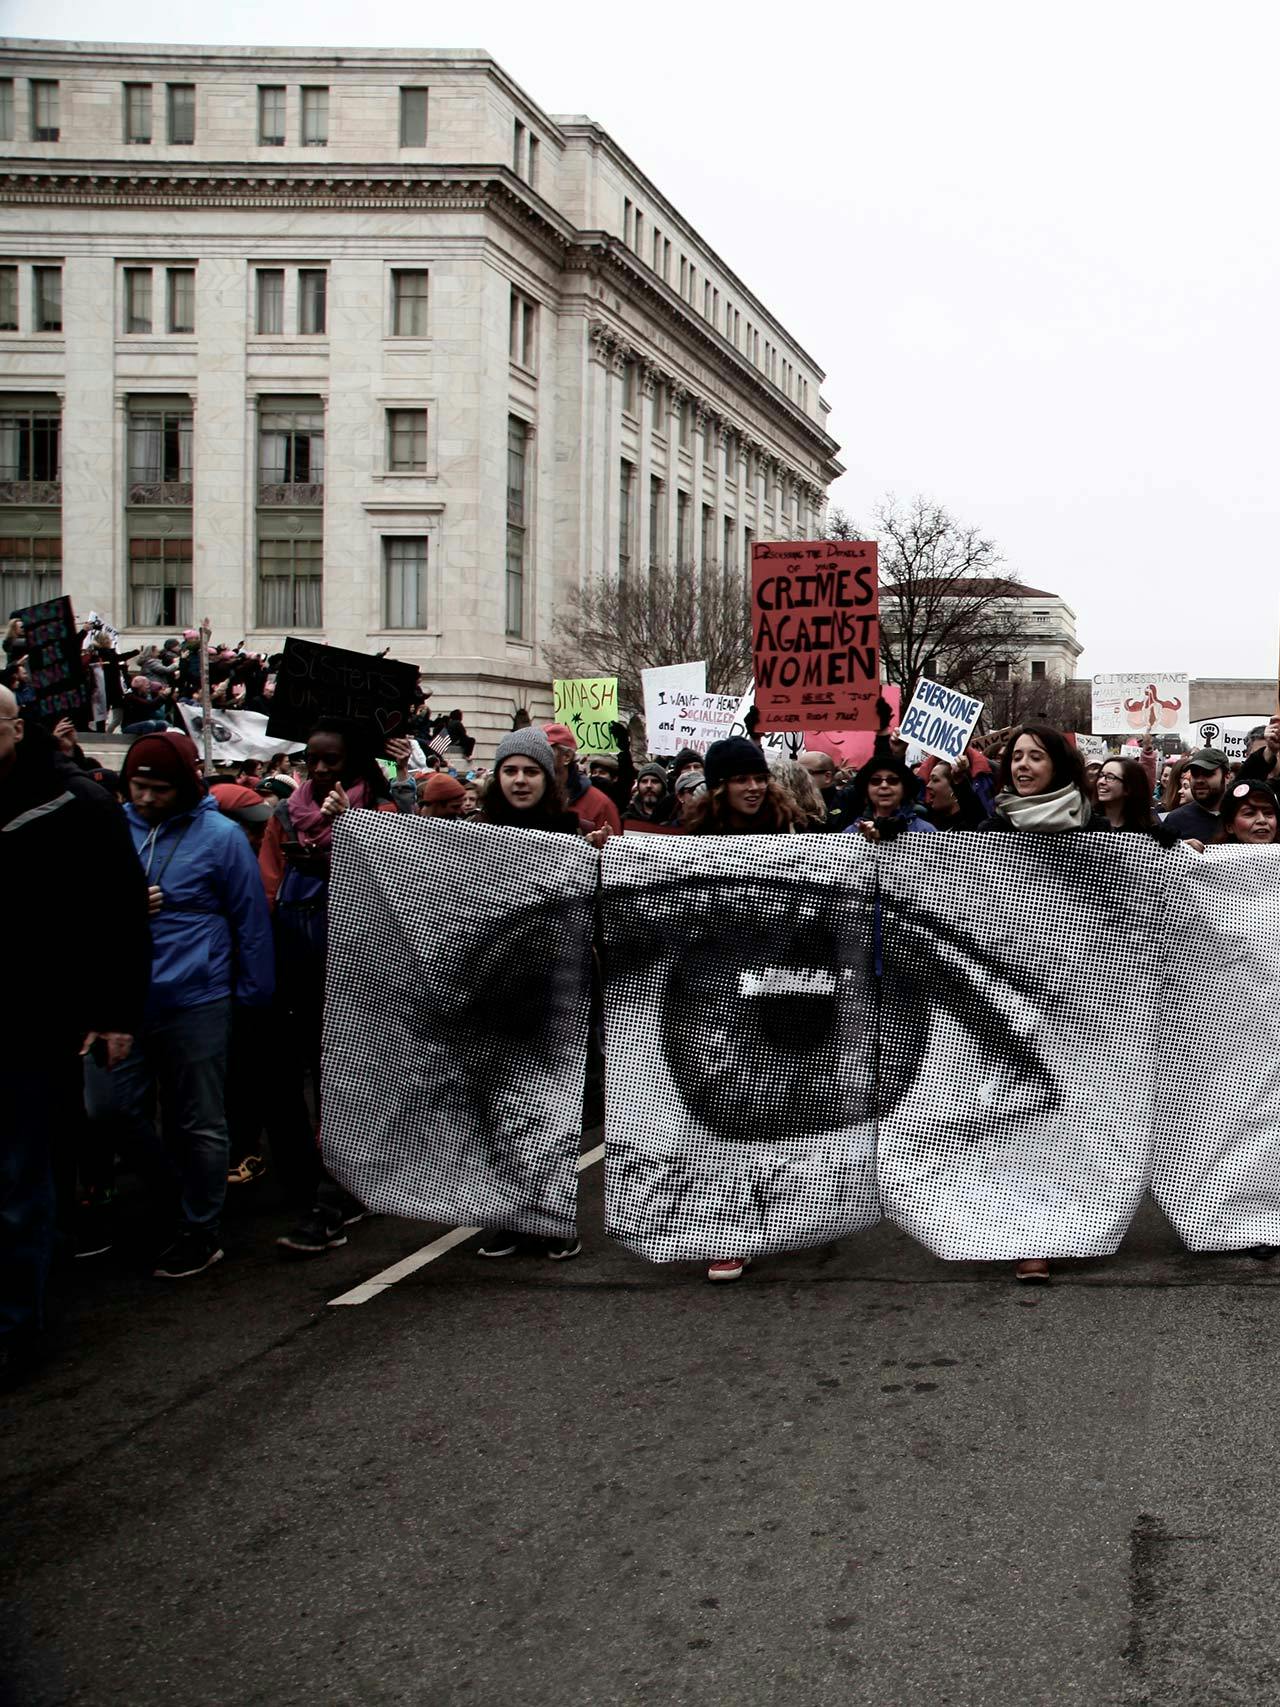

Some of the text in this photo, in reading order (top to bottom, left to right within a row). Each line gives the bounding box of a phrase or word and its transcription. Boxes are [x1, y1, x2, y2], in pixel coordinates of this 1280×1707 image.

[757, 567, 874, 611] CRIMES
[787, 565, 800, 574] OF
[755, 610, 877, 652] AGAINST
[755, 646, 876, 688] WOMEN
[658, 692, 667, 706] I
[916, 682, 979, 724] EVERYONE
[658, 718, 676, 731] and
[681, 726, 696, 736] my
[901, 706, 968, 757] BELONGS
